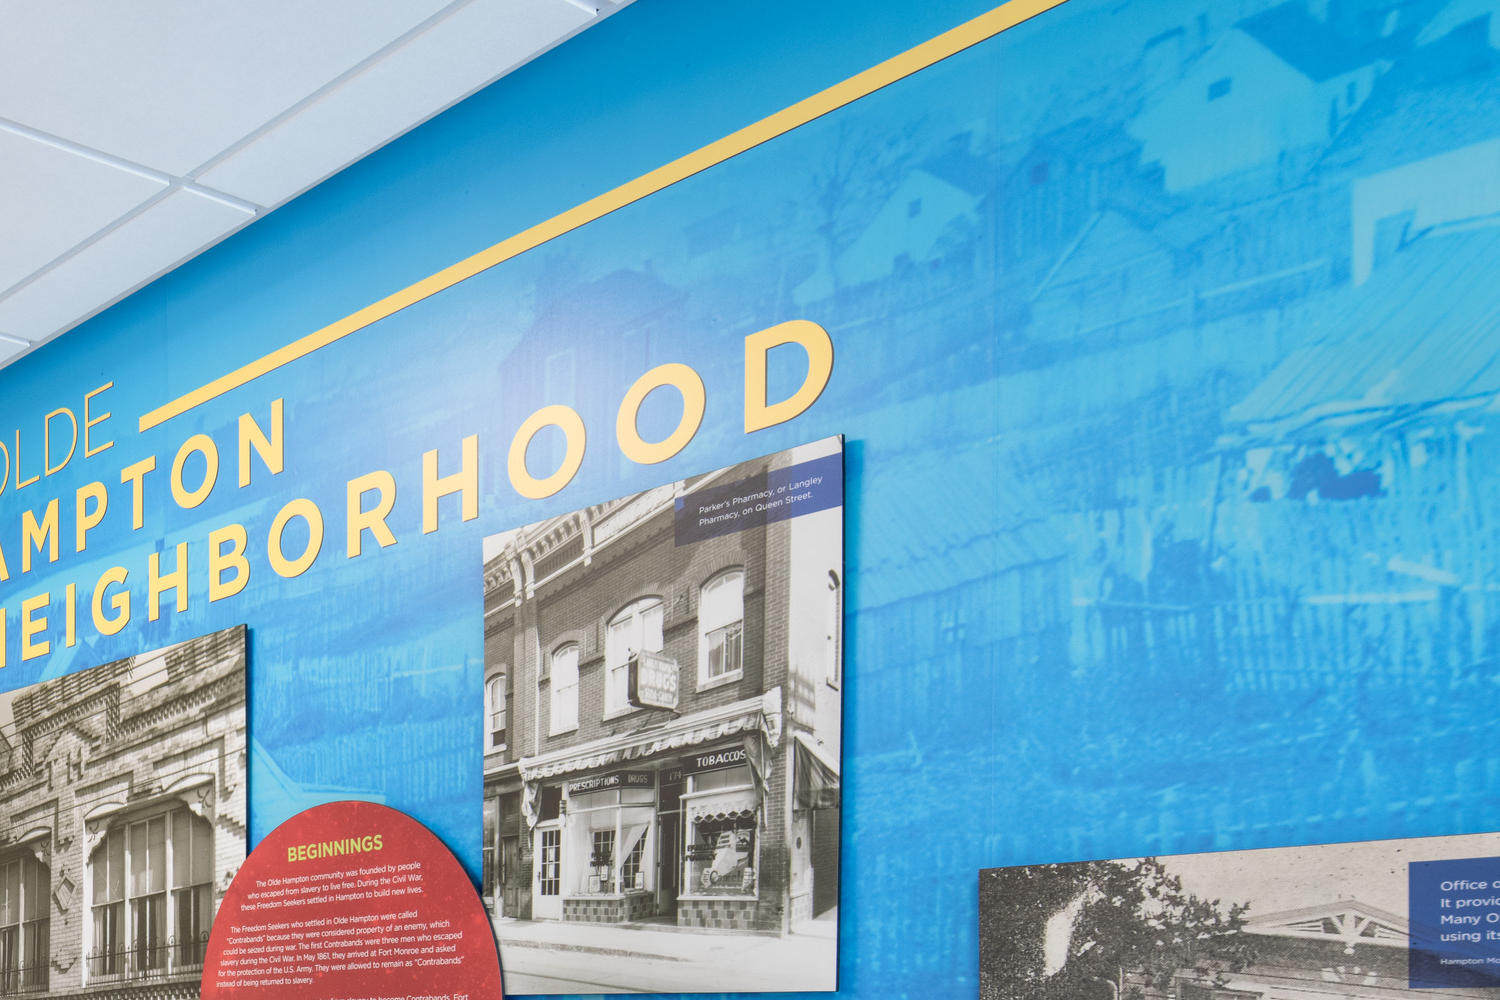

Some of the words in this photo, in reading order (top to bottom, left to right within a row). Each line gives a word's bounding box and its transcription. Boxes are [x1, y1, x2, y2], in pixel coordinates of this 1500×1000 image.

[732, 489, 775, 505] Pharmacy,
[777, 485, 786, 493] or
[789, 476, 822, 490] Langley
[699, 511, 740, 526] Pharmacy,
[742, 507, 753, 515] on
[755, 500, 783, 511] Queen
[785, 491, 813, 504] Street.
[696, 750, 746, 767] TOBACCOS
[569, 775, 619, 792] PRESCRIPTIONS
[628, 774, 648, 783] DRUGS
[288, 835, 383, 862] BEGINNINGS
[255, 880, 267, 888] The
[267, 878, 281, 886] Olde
[282, 875, 310, 885] Hampton
[310, 871, 344, 881] community
[359, 865, 387, 876] founded
[387, 865, 396, 874] by
[397, 862, 422, 873] people
[247, 891, 260, 899] who
[260, 888, 285, 898] escaped
[300, 886, 321, 894] slavery
[322, 884, 329, 892] to
[330, 883, 341, 891] live
[357, 879, 379, 888] During
[392, 876, 407, 884] Civil
[408, 875, 424, 883] War,
[1440, 880, 1488, 891] Office
[1440, 899, 1451, 908] It
[1440, 915, 1481, 925] Many
[1440, 931, 1481, 942] using
